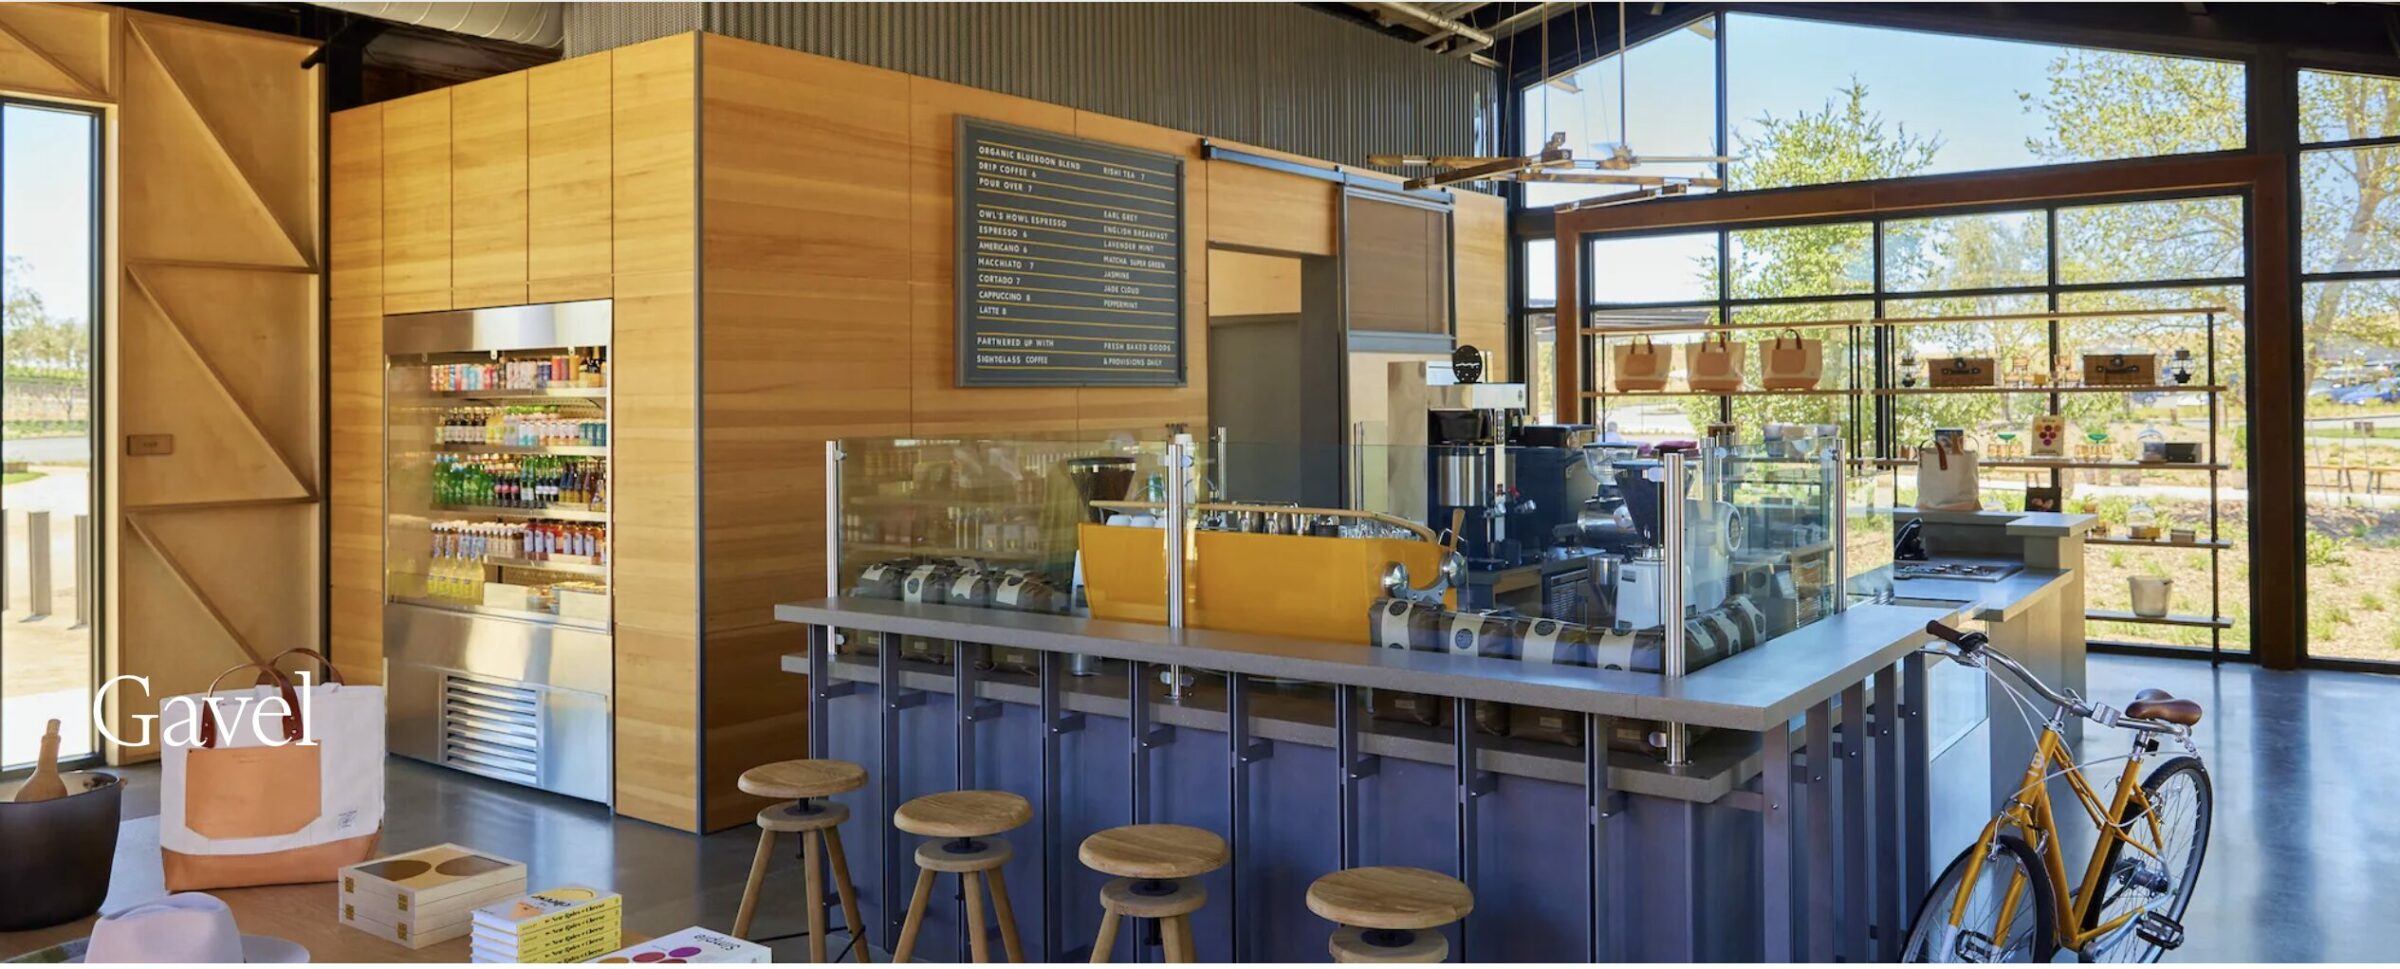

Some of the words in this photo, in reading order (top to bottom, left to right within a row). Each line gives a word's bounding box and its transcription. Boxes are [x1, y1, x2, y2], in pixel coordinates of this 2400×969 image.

[978, 146, 1014, 158] ORGANIC
[1017, 151, 1056, 166] BLUEBOON
[1058, 160, 1080, 170] BLEND
[979, 162, 997, 172] DRIP
[1000, 165, 1027, 177] COFFEE
[1103, 166, 1121, 176] RISHI
[1123, 170, 1135, 179] TEA
[1141, 173, 1145, 181] 7
[979, 177, 1000, 188] POUR
[1004, 181, 1023, 191] OVER
[979, 210, 1004, 220] OWL'S
[1006, 213, 1029, 223] HOWL
[1031, 216, 1067, 228] ESPRESSO
[1104, 210, 1120, 220] EARL
[1121, 213, 1138, 222] GREY
[979, 225, 1018, 237] ESPRESSO
[1104, 225, 1132, 236] ENGLISH
[1134, 229, 1168, 240] BREAKFAST
[979, 242, 1020, 253] AMERICANO
[1104, 240, 1136, 250] LAVENDER
[1138, 244, 1154, 252] MINT
[978, 258, 1022, 269] MACCHIATO
[1030, 262, 1034, 270] 7
[1103, 256, 1127, 264] MATCHA
[1130, 259, 1146, 267] SUPER
[1148, 261, 1166, 269] GREEN
[979, 274, 1013, 285] CORTADO
[1104, 271, 1130, 280] JASMINE
[979, 290, 1022, 301] CAPPUCCINO
[1104, 285, 1118, 293] JADE
[1120, 286, 1140, 295] CLOUD
[1104, 300, 1138, 308] PEPPERMINT
[979, 306, 999, 315] LATTE
[977, 337, 1020, 346] PARTNERED
[1036, 339, 1054, 347] WITH
[1104, 342, 1124, 351] FRESH
[1126, 343, 1147, 351] BAKED
[1149, 344, 1171, 352] GOODS
[976, 355, 1020, 364] SIGHTGLASS
[1025, 356, 1048, 364] COFFEE
[1108, 358, 1145, 366] PROVISIONS
[1147, 358, 1162, 366] DAILY
